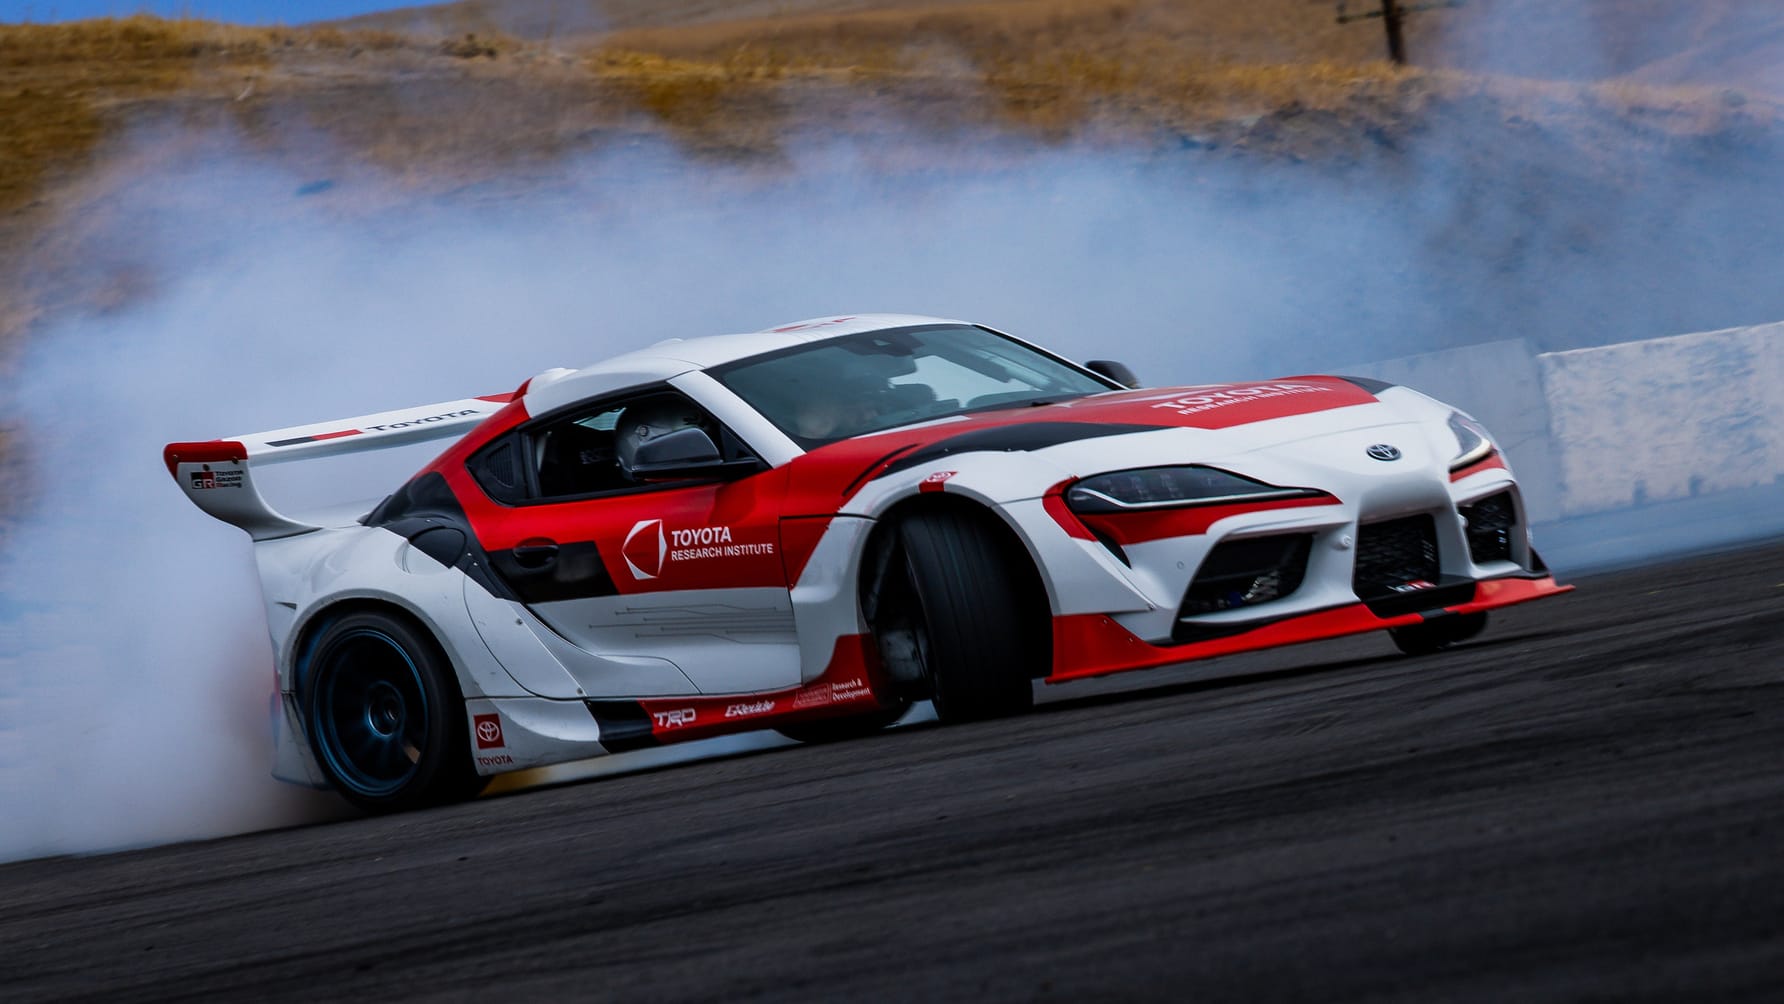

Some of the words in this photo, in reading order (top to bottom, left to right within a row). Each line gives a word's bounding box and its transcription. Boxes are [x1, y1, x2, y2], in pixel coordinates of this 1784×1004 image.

[1150, 384, 1312, 409] TOYOTA
[365, 409, 480, 431] TOYOTA
[192, 479, 215, 489] GR
[671, 526, 732, 547] TOYOTA
[671, 547, 722, 561] RESEARCH
[724, 543, 774, 556] INSTITUTE
[832, 679, 857, 691] Research
[832, 687, 871, 702] Development
[653, 708, 696, 728] TRD
[478, 754, 514, 766] TOYOTA
